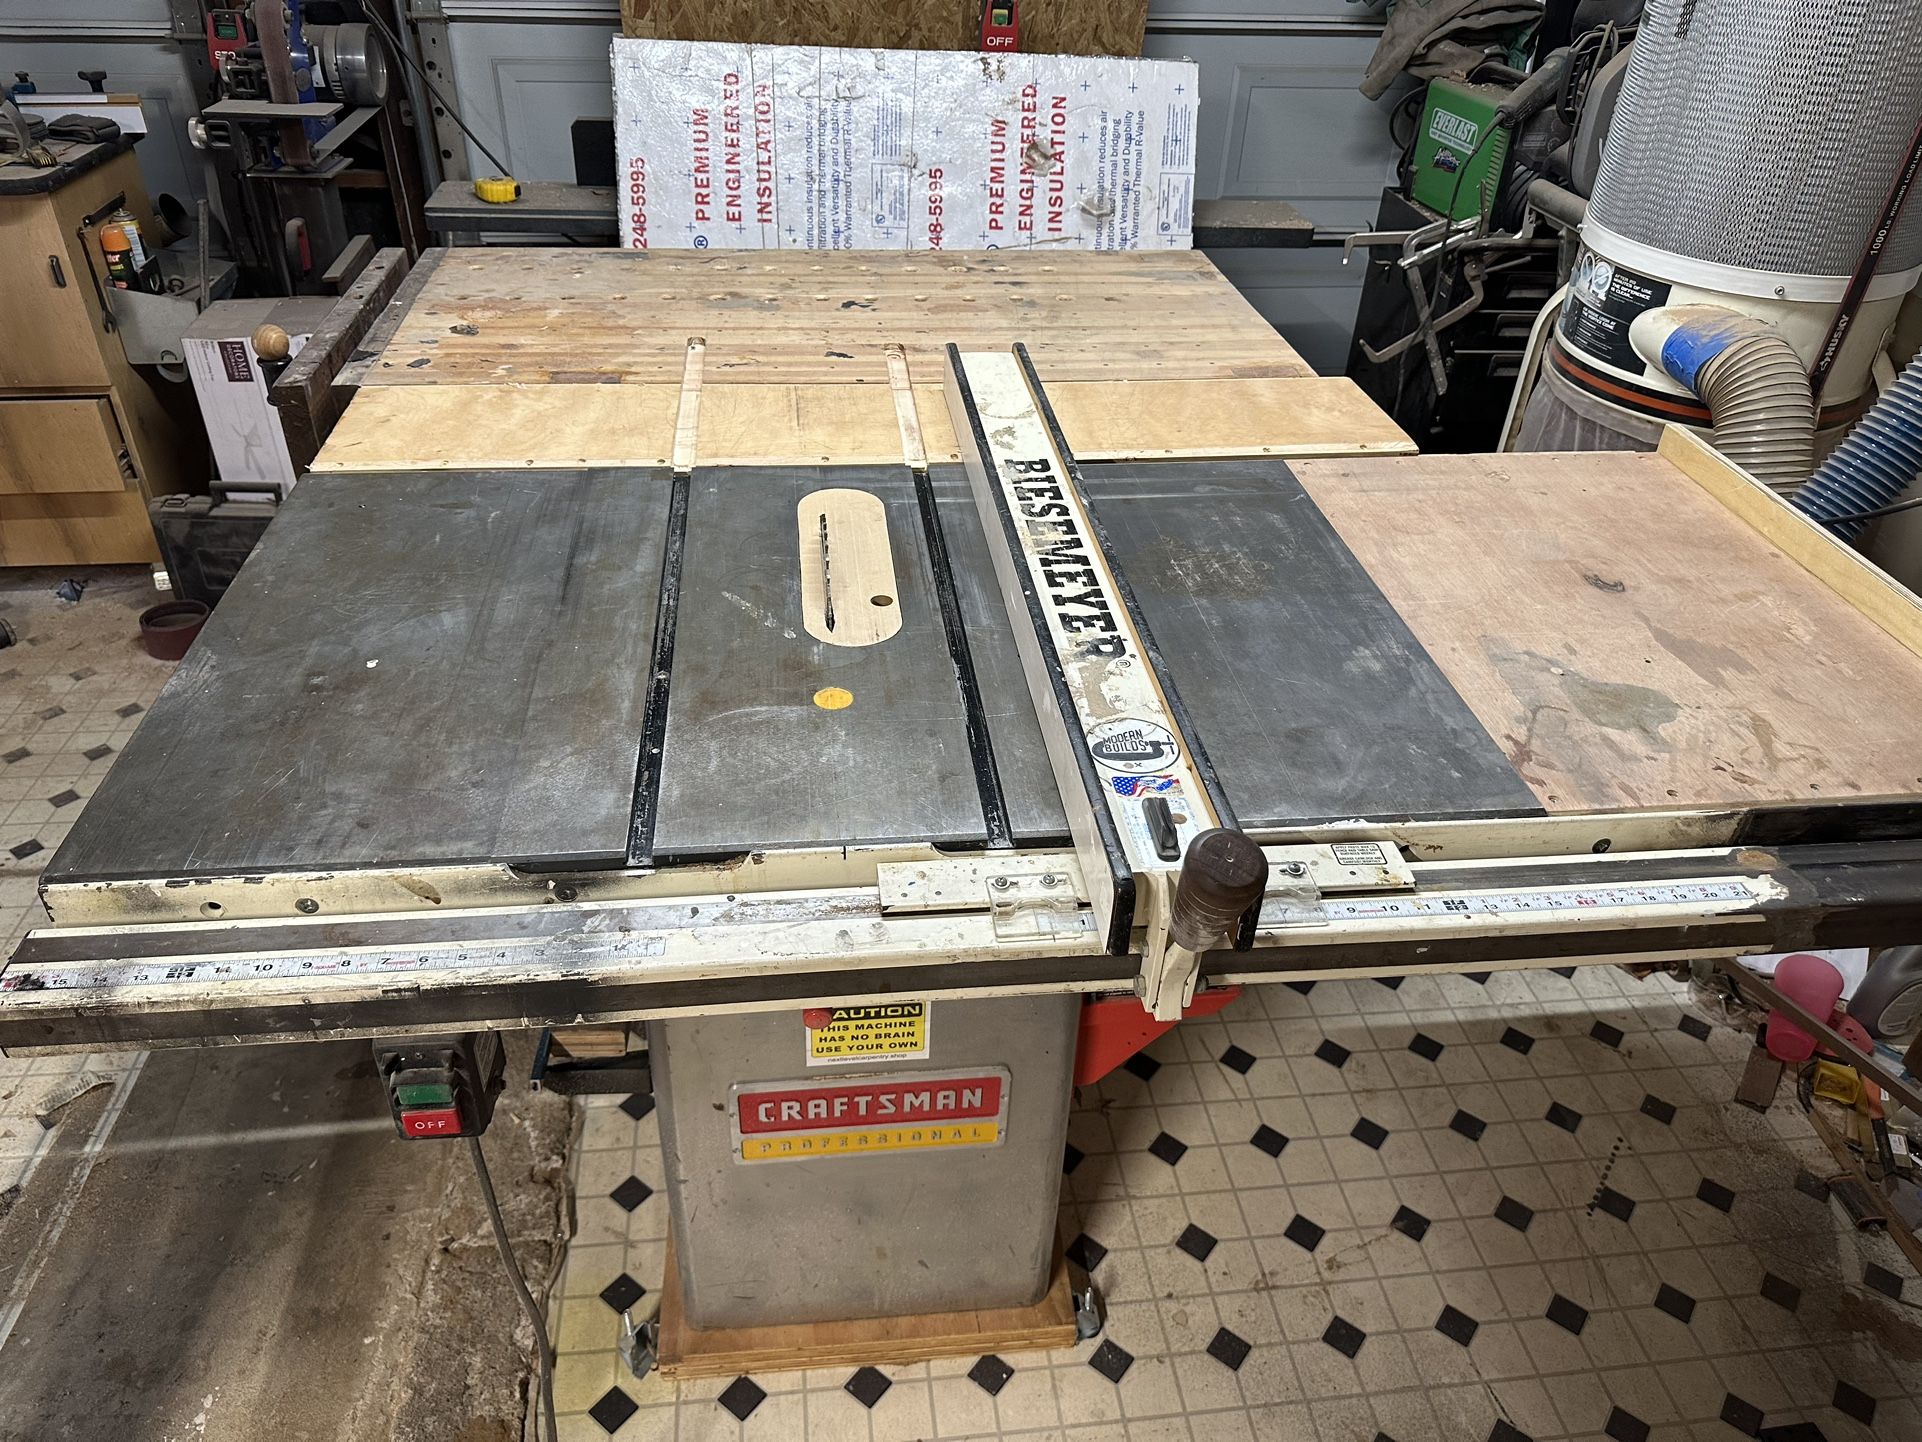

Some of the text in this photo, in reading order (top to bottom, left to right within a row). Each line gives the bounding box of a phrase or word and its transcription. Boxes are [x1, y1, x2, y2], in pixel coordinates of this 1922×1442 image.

[214, 51, 236, 60] STO
[987, 36, 1013, 46] OFF
[804, 114, 813, 153] reduces
[830, 98, 841, 145] Durability
[1100, 110, 1108, 123] air
[1122, 110, 1134, 156] Durability
[1135, 110, 1145, 147] R-Value
[1432, 112, 1476, 142] EVERLAST
[724, 71, 743, 223] ENGINEERED
[754, 83, 773, 224] INSULATION
[831, 147, 840, 166] and
[1099, 126, 1108, 164] reduces
[1111, 119, 1121, 157] bridging
[692, 108, 710, 221] PREMIUM
[843, 138, 852, 178] Thermal
[989, 118, 1007, 231] PREMIUM
[1018, 84, 1037, 232] ENGINERED
[1047, 95, 1066, 232] INSULATION
[1121, 158, 1130, 177] and
[1132, 149, 1143, 188] Thermal
[1109, 160, 1118, 197] thermal
[629, 157, 647, 248] 248-5995
[843, 181, 852, 231] Warranted
[1119, 179, 1130, 224] Versatility
[1131, 190, 1141, 239] Warranted
[1871, 230, 1887, 255] 1000
[1889, 185, 1907, 217] WORKING
[1905, 164, 1916, 183] LOAD
[1825, 314, 1849, 357] HUSKY
[231, 343, 250, 380] HOME
[1004, 458, 1127, 660] BIESEMEYER
[1103, 729, 1143, 744] MODERN
[1104, 740, 1147, 752] BUILDS
[253, 964, 274, 972] 10
[380, 957, 391, 965] 7
[457, 953, 468, 961] 5
[833, 1005, 920, 1019] AUTION
[855, 1021, 916, 1031] MACHINE
[816, 1041, 918, 1054] USE YOUR OWN
[819, 1034, 845, 1043] HAS
[874, 1031, 915, 1040] BRAIN
[757, 1087, 983, 1123] CRAFTSMAN
[414, 1120, 446, 1129] OFF
[761, 1128, 981, 1153] PROFESSIONAL
